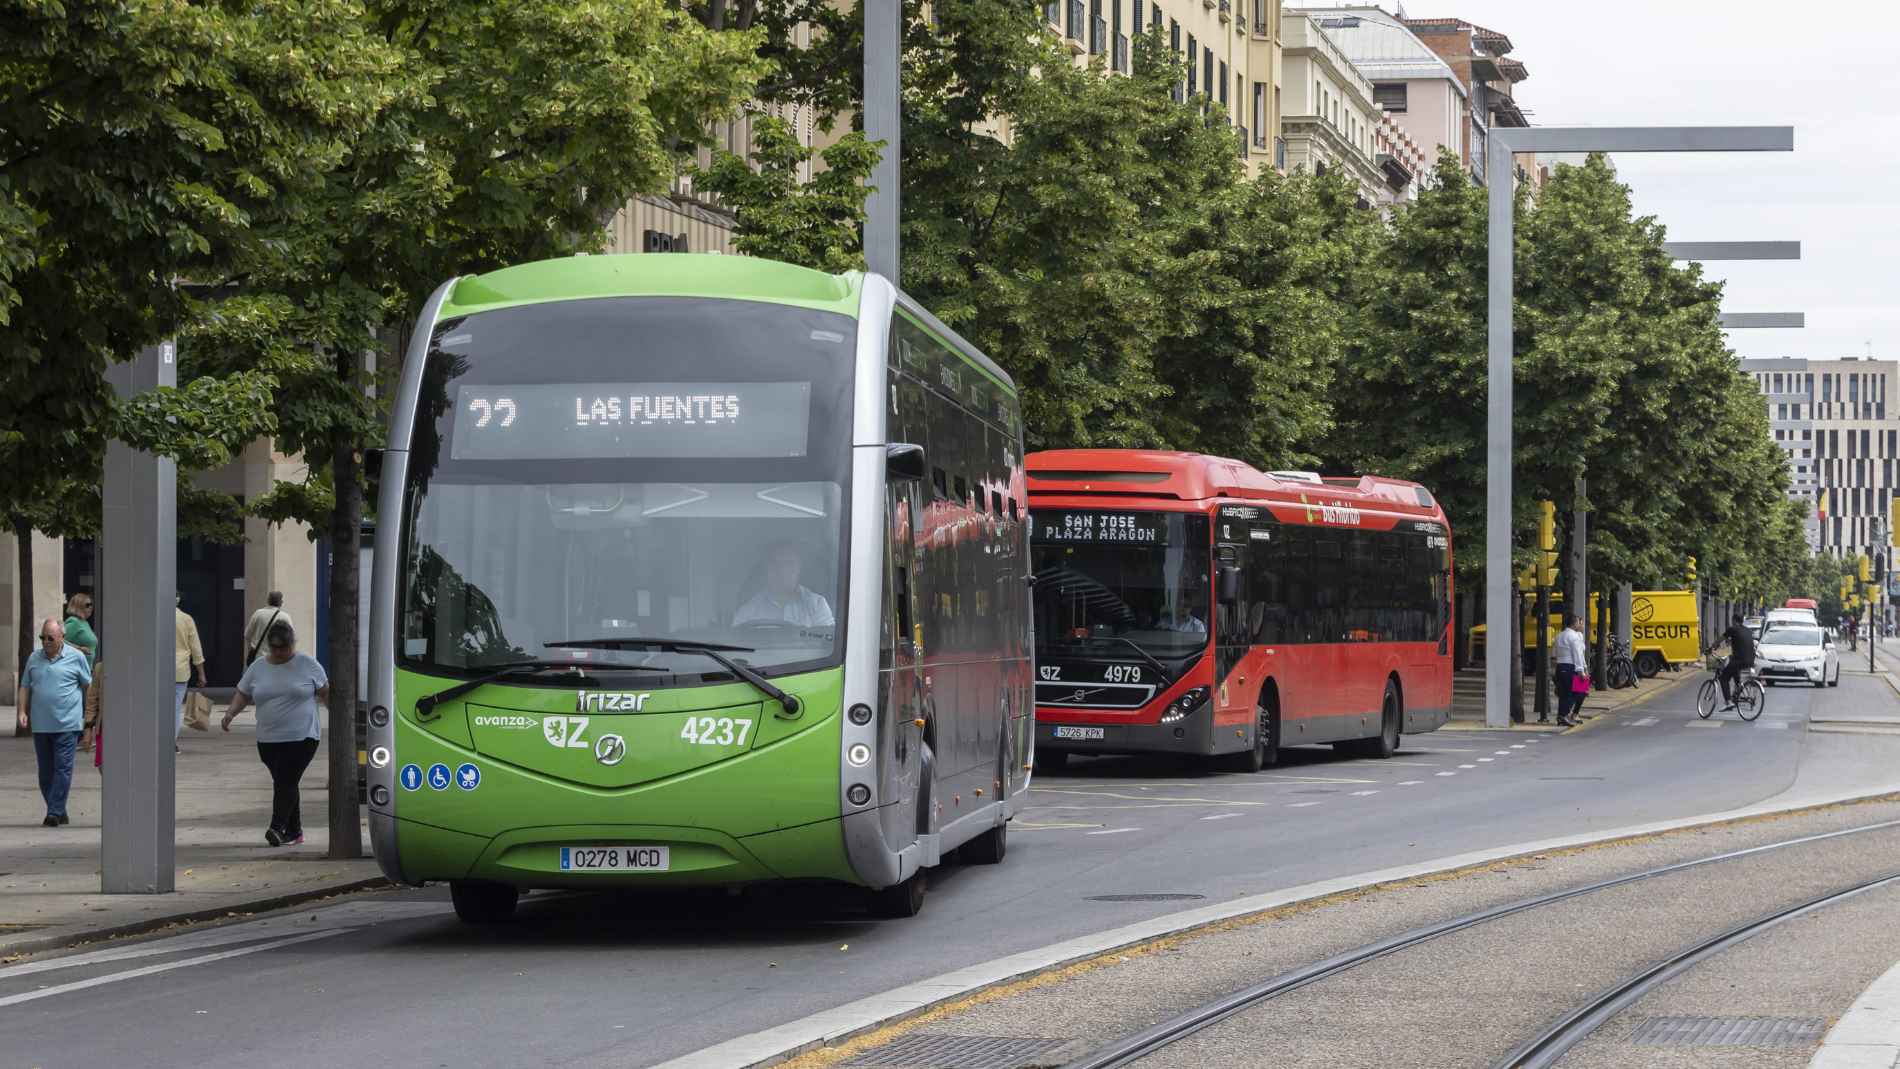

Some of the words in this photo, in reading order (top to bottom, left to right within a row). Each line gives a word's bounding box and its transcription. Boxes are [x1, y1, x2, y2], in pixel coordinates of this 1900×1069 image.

[576, 397, 622, 425] LAS
[630, 395, 740, 424] FUENTES
[1065, 515, 1093, 528] SAN
[1100, 515, 1136, 528] JOSE
[1046, 526, 1093, 539] PLAZA
[1100, 527, 1155, 541] ARAGON
[1633, 625, 1690, 639] SEGUR
[1104, 665, 1141, 682] 4979
[475, 716, 526, 727] avanza
[681, 716, 753, 746] 4237
[575, 850, 618, 867] 0278
[626, 850, 660, 867] MCD
